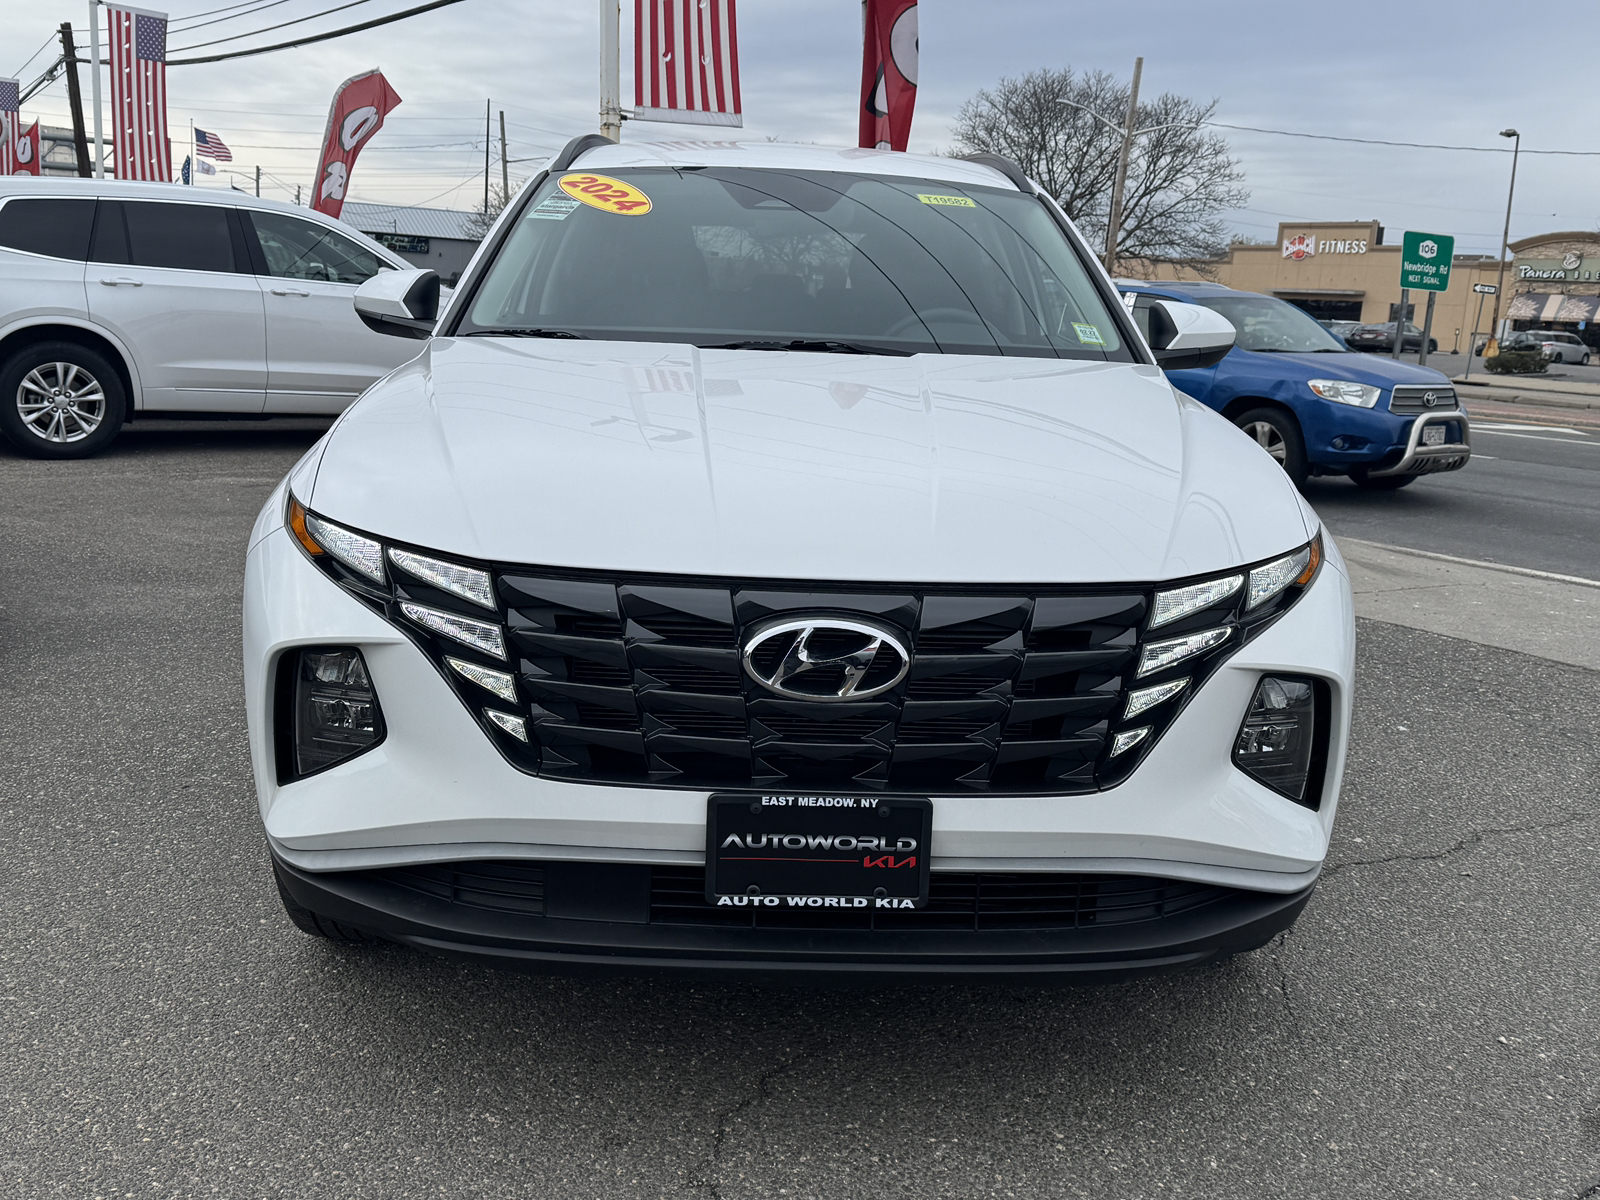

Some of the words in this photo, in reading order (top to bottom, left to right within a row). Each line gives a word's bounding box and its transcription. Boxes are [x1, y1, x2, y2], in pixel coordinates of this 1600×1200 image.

[562, 176, 648, 212] 2024
[924, 196, 970, 206] T19582
[1319, 240, 1367, 254] FITNESS
[1421, 244, 1436, 255] 106
[1403, 261, 1437, 275] Newbridge
[1439, 264, 1448, 275] Rd
[1519, 265, 1566, 279] Panera
[1408, 275, 1421, 283] NEXT
[1423, 276, 1440, 285] SIGNAL
[762, 796, 795, 806] EAST
[861, 798, 879, 808] NY
[720, 832, 917, 852] AUTOWORLD
[863, 855, 917, 869] KIA
[716, 896, 780, 907] AUTO
[786, 896, 869, 908] WORLD
[875, 897, 916, 909] KIA
